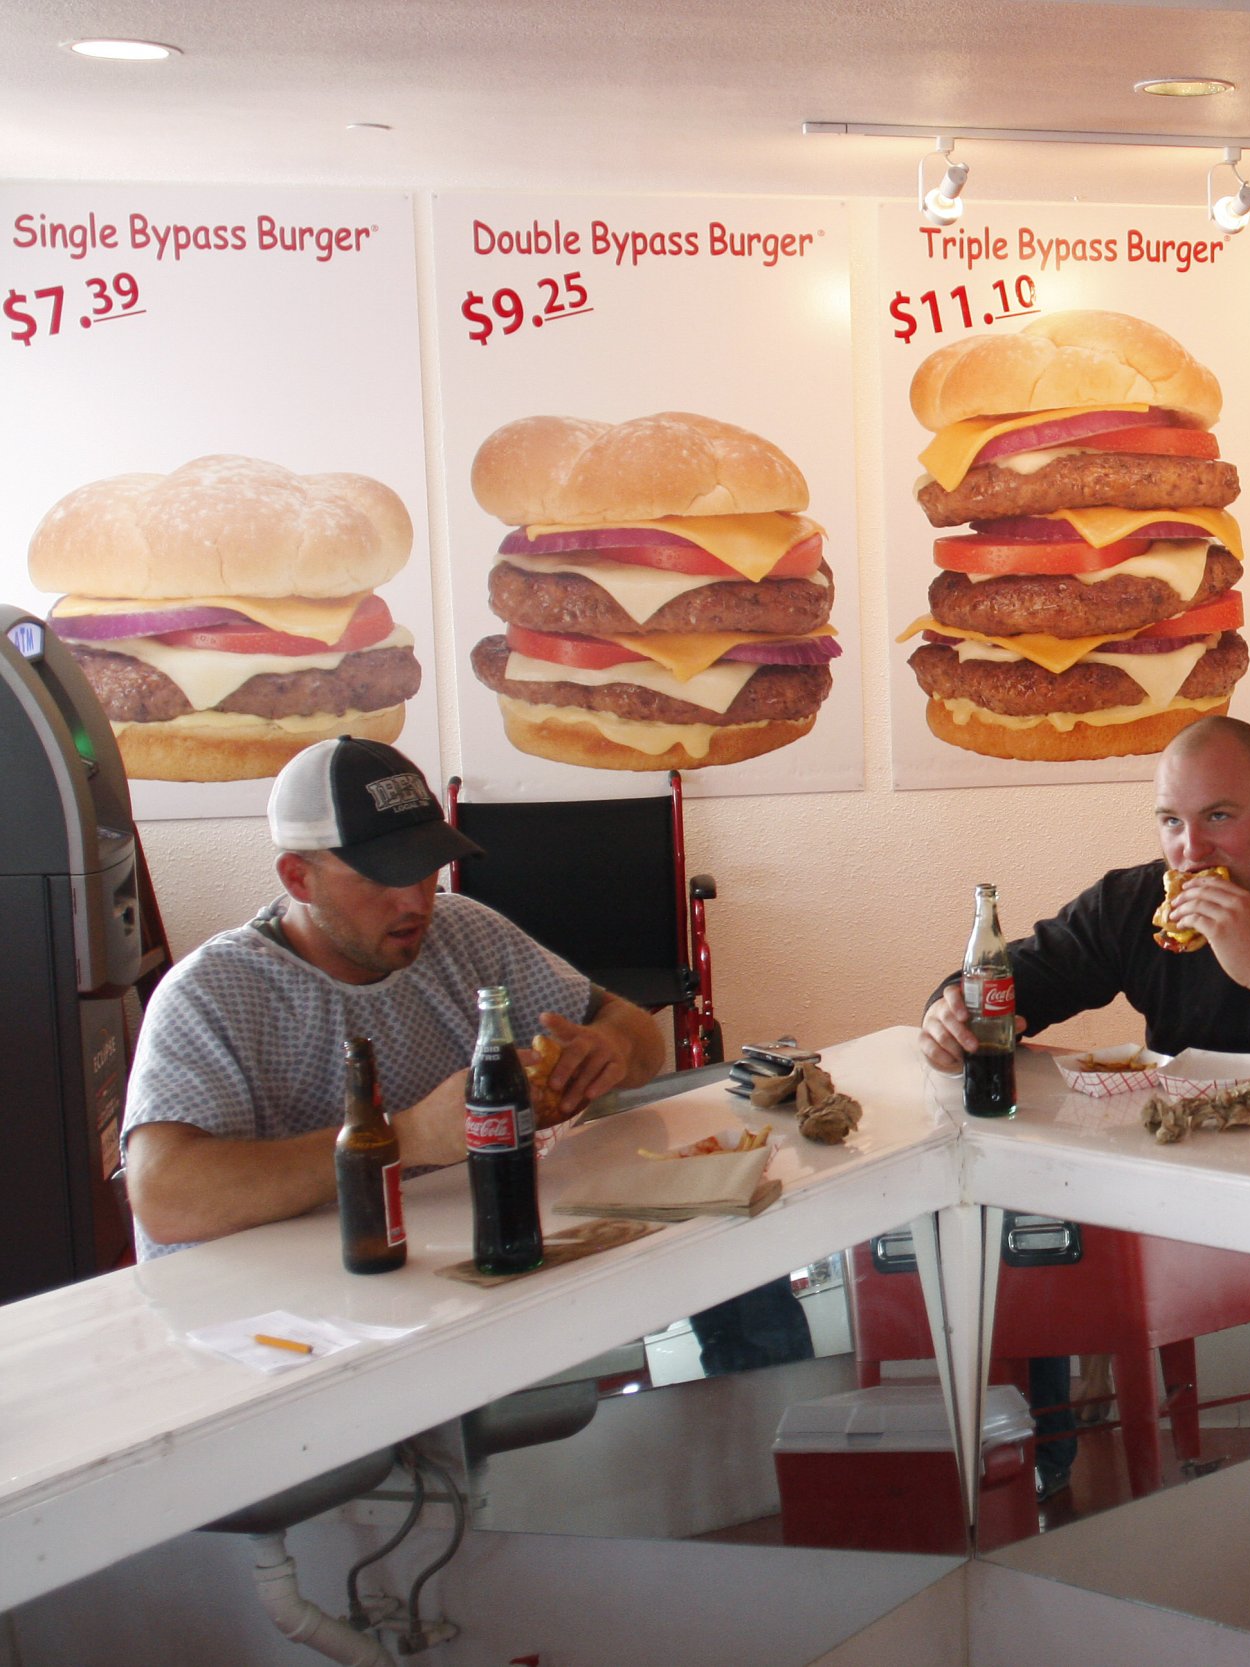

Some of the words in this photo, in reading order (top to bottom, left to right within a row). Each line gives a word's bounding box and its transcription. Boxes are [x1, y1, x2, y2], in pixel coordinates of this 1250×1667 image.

[13, 212, 118, 259] Single
[129, 213, 246, 261] Bypass
[473, 219, 581, 255] Double
[591, 221, 699, 266] Bypass
[919, 226, 1008, 270] Triple
[1018, 227, 1117, 271] Bypass
[2, 272, 141, 346] $7.39
[461, 271, 588, 346] $9.25
[14, 627, 35, 653] ATM
